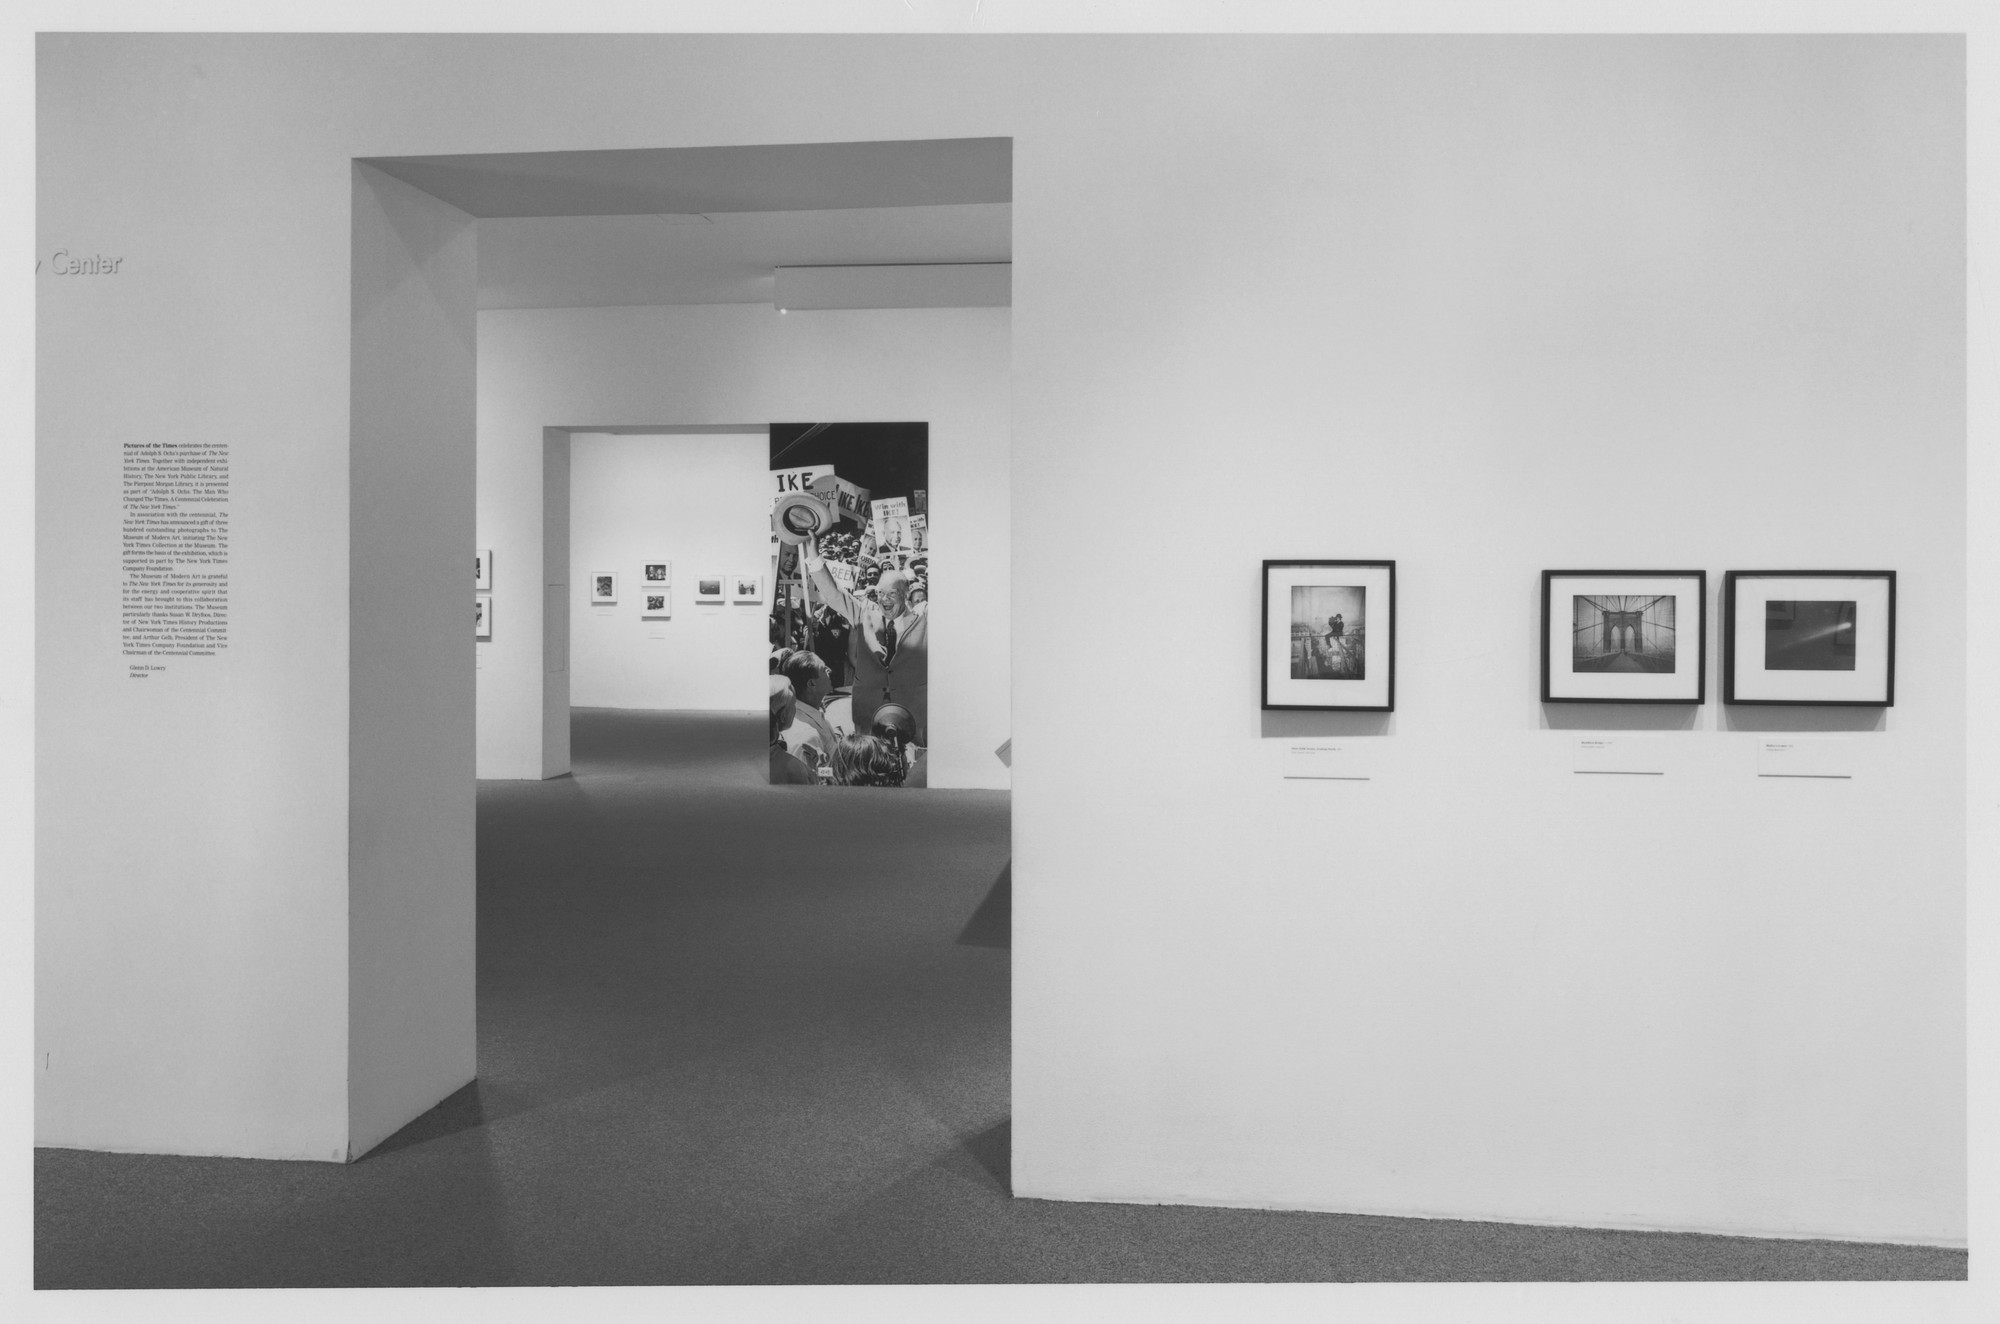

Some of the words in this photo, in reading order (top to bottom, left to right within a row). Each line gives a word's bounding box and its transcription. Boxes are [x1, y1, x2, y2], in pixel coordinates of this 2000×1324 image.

[52, 248, 123, 275] Center
[777, 472, 813, 492] IKE
[130, 488, 140, 496] part
[811, 490, 836, 501] HOICE
[200, 519, 208, 527] gift
